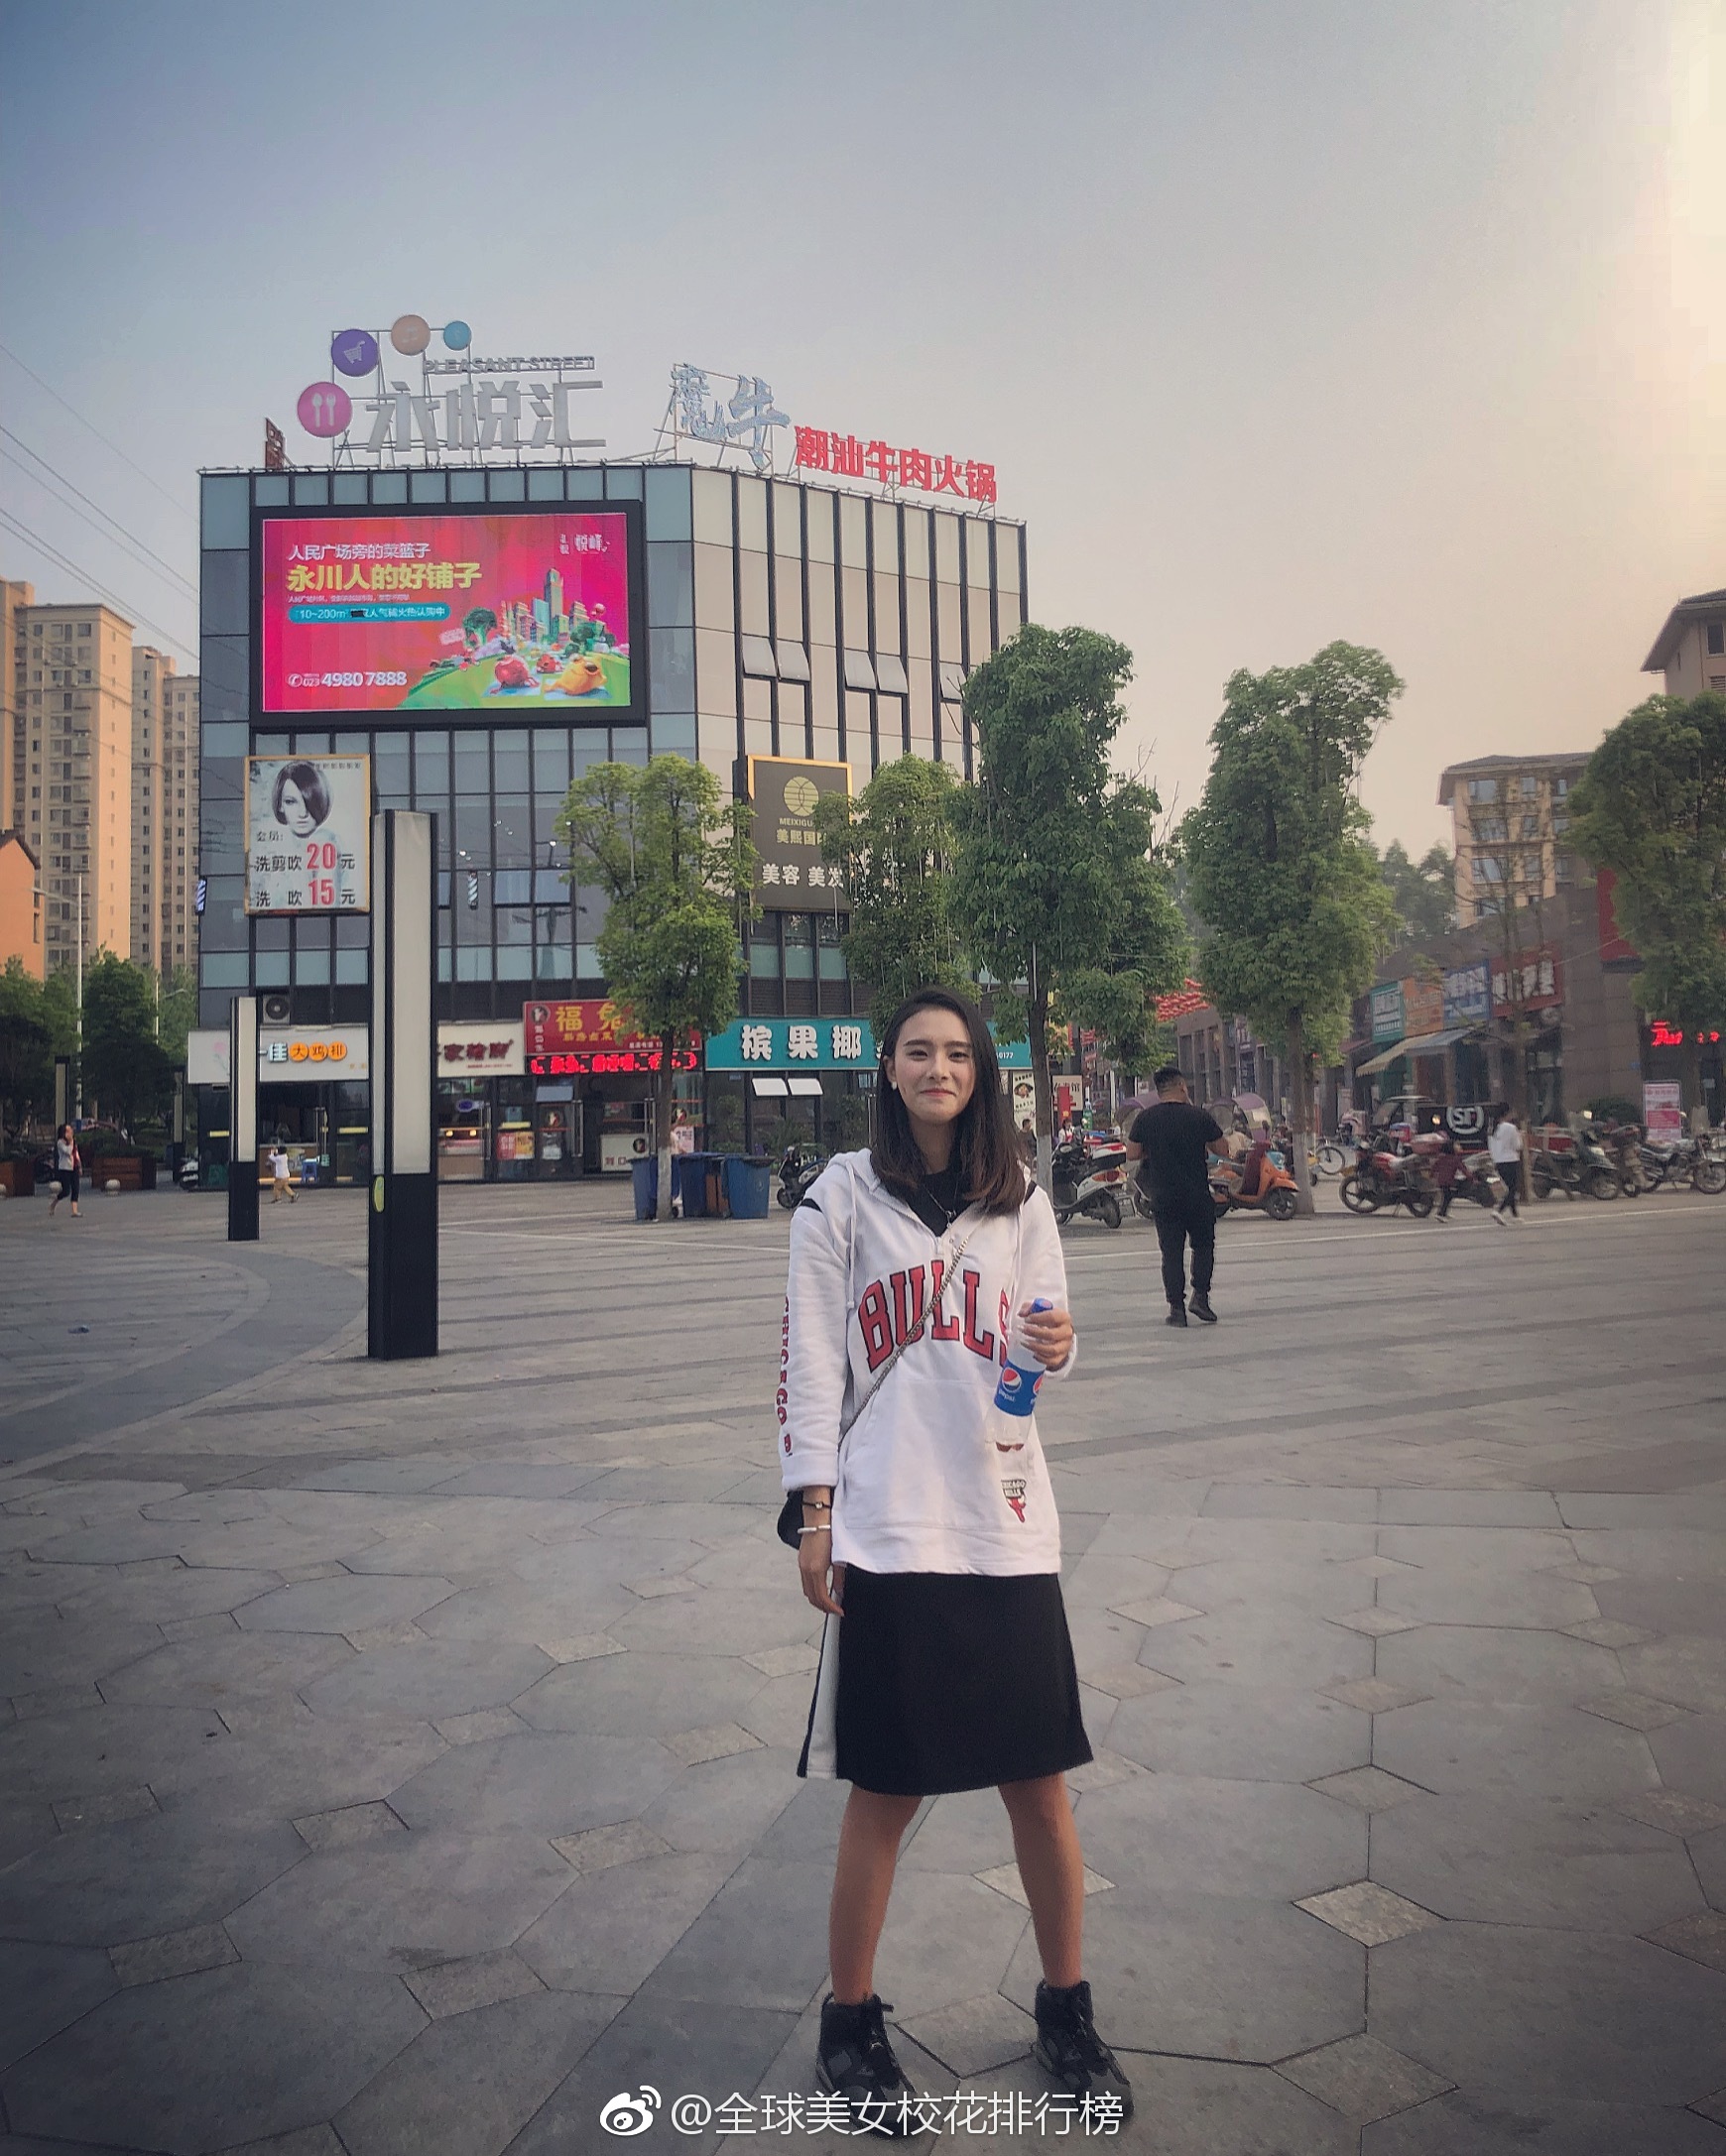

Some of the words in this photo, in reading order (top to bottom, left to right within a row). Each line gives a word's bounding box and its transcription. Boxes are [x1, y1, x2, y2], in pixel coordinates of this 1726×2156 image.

[424, 357, 525, 374] PLEASANT
[529, 355, 595, 372] STREET
[366, 380, 606, 453] 永悦汇
[795, 424, 998, 504] 潮汕牛肉火锅
[288, 542, 431, 561] 人民广场旁的菜篮子
[287, 561, 482, 592] 永川人的好铺子
[321, 672, 363, 687] 4980
[365, 671, 408, 686] 7888
[779, 817, 813, 828] MEIXIGU
[255, 854, 302, 873] 洗剪吹
[307, 843, 336, 871] 20
[340, 853, 356, 871] 元
[762, 863, 801, 886] 美容
[808, 866, 844, 889] 美发
[255, 890, 271, 907] 洗
[288, 890, 303, 906] 吹
[308, 879, 335, 906] 15
[341, 888, 356, 905] 元
[741, 1023, 883, 1060] 槟果椰
[998, 1388, 1016, 1403] pepsi
